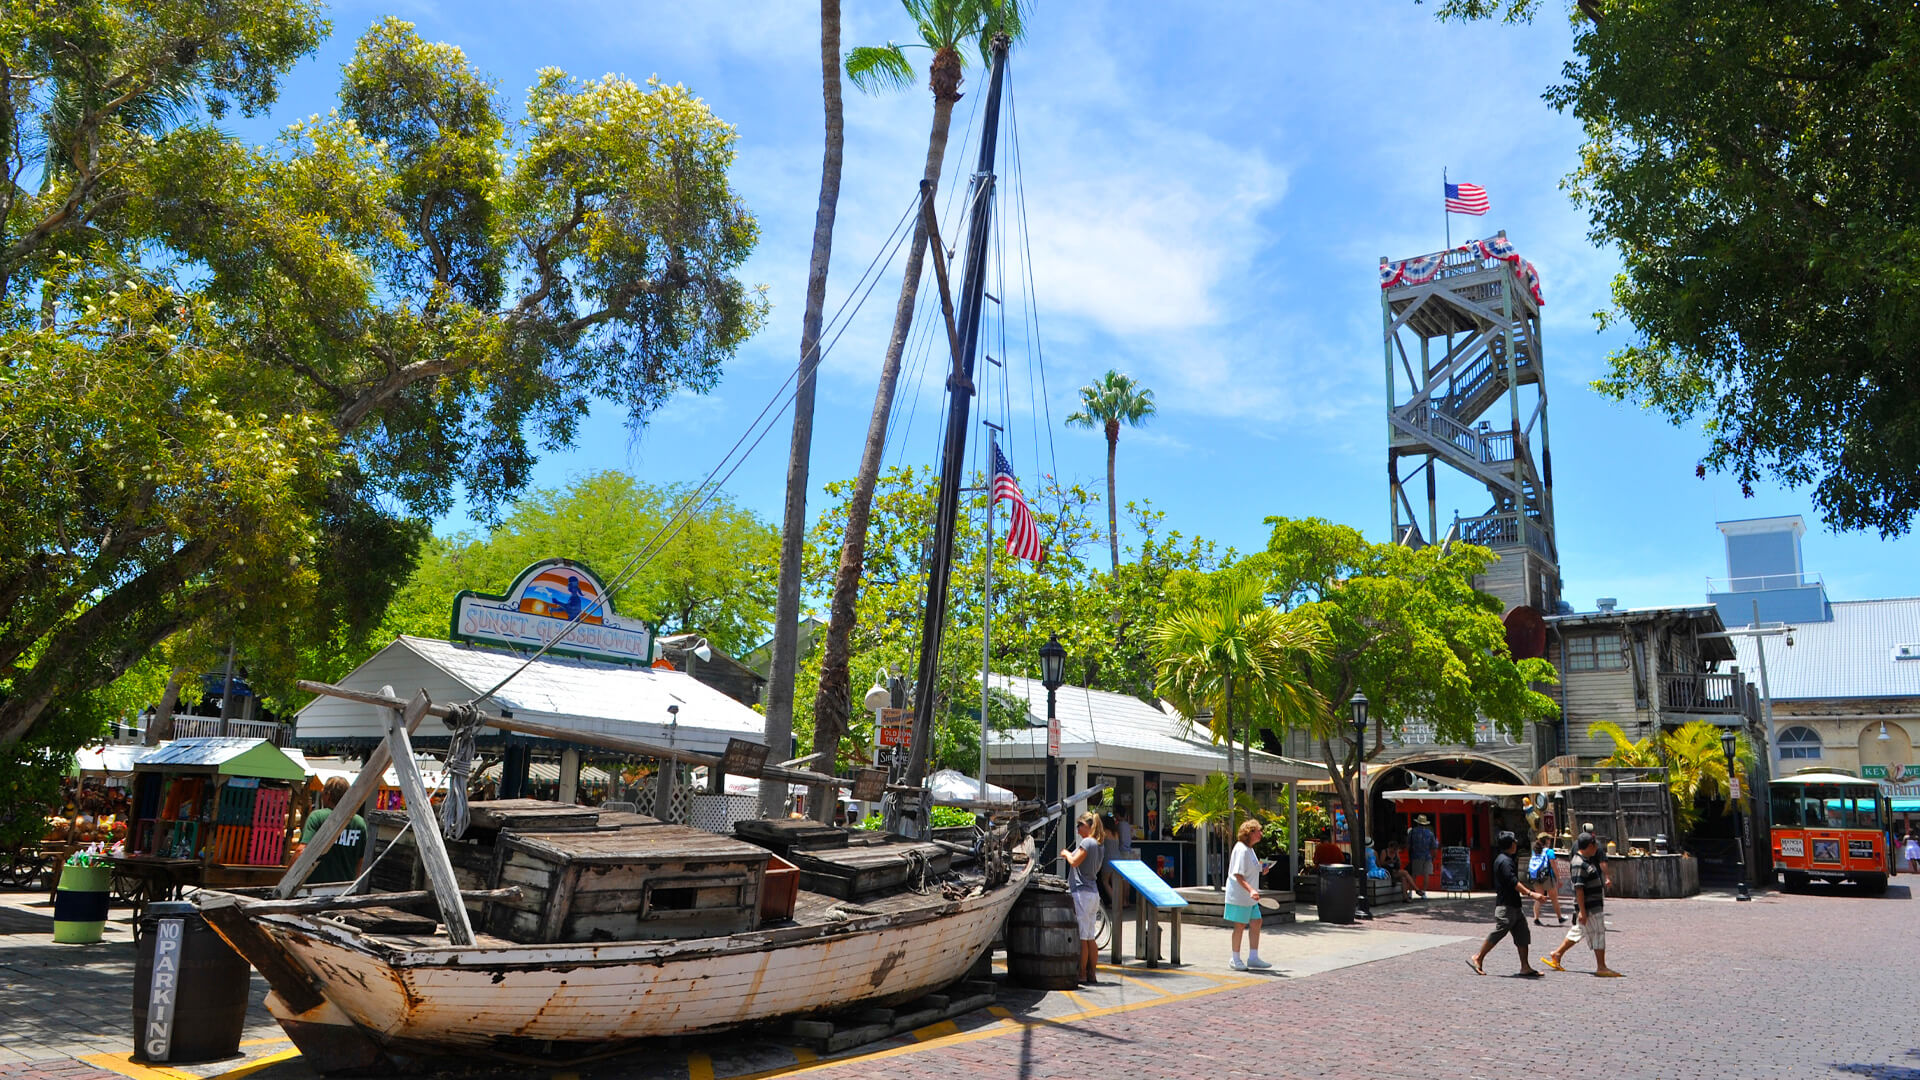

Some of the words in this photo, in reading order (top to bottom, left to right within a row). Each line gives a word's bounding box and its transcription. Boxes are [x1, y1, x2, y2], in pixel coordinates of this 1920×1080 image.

[465, 607, 529, 639] SUNSET
[884, 729, 898, 737] OLD
[1864, 767, 1887, 776] KEY
[159, 923, 180, 939] NO
[147, 940, 176, 1056] PARKING
